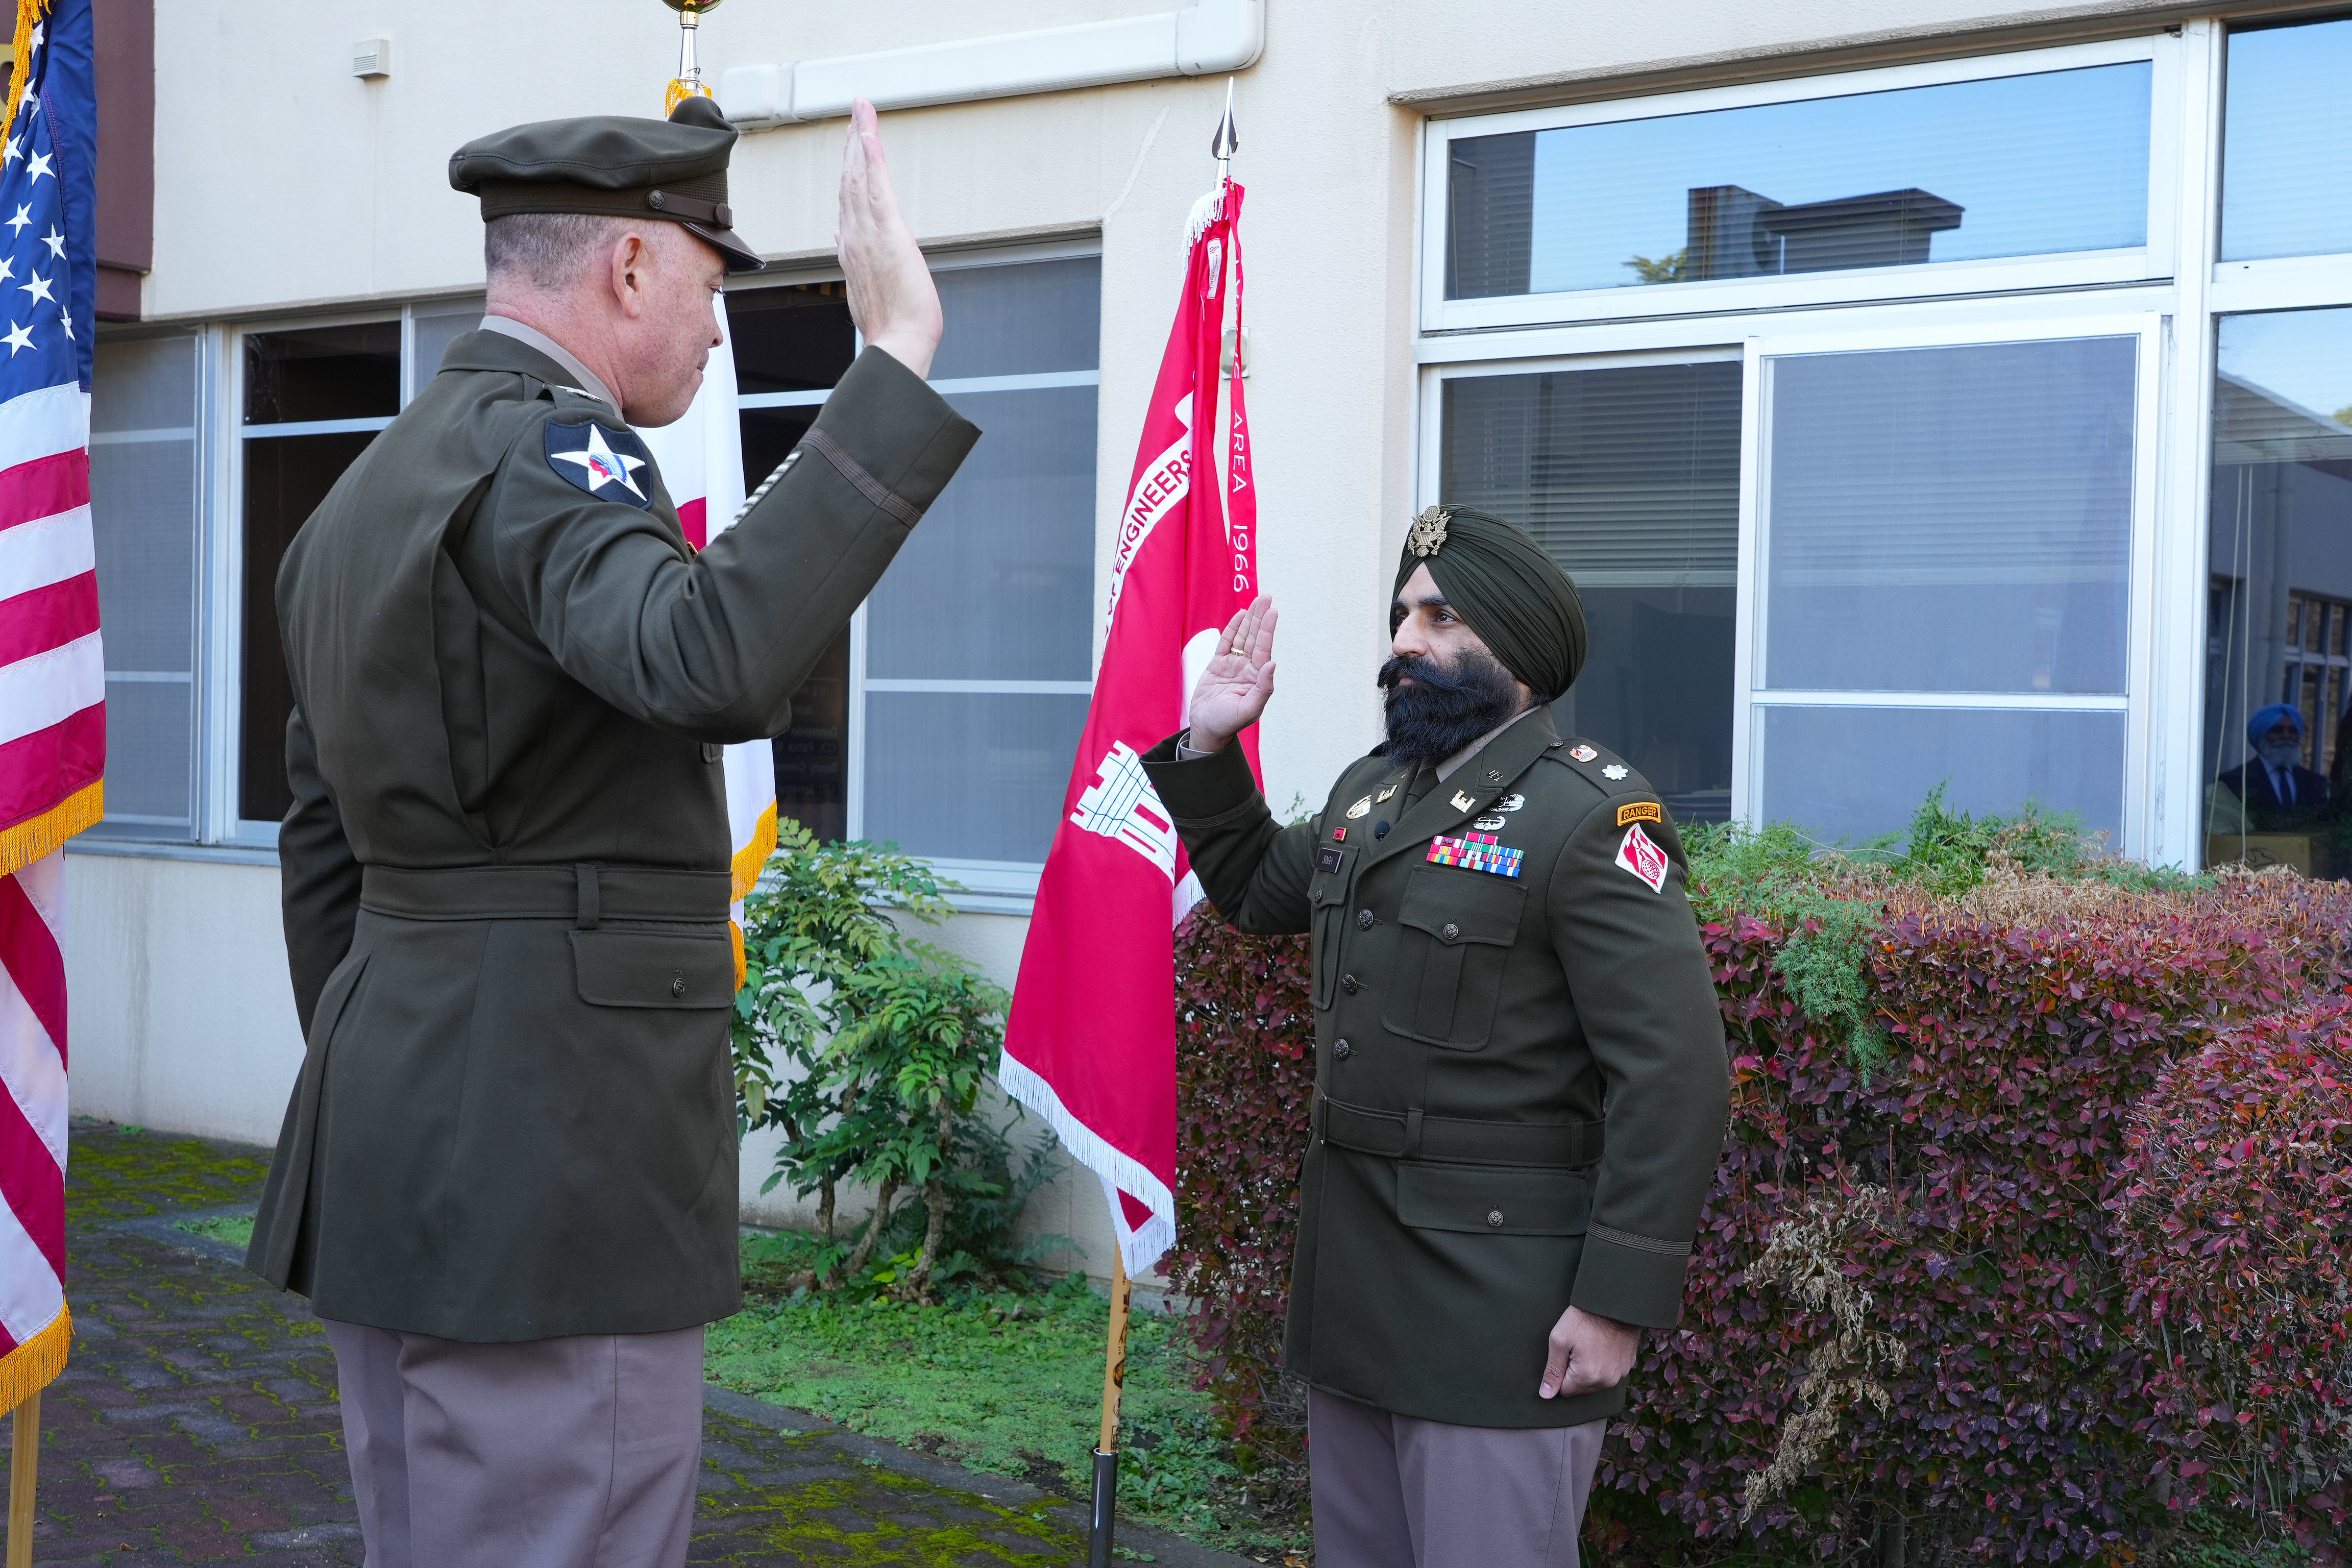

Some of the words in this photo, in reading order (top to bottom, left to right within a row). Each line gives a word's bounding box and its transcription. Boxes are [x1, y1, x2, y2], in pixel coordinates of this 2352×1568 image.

[1233, 409, 1247, 493] AREA
[1115, 450, 1192, 575] ENGINEERS
[1233, 525, 1250, 593] 1966
[1624, 807, 1657, 820] RANGER
[1322, 855, 1334, 866] SINGH
